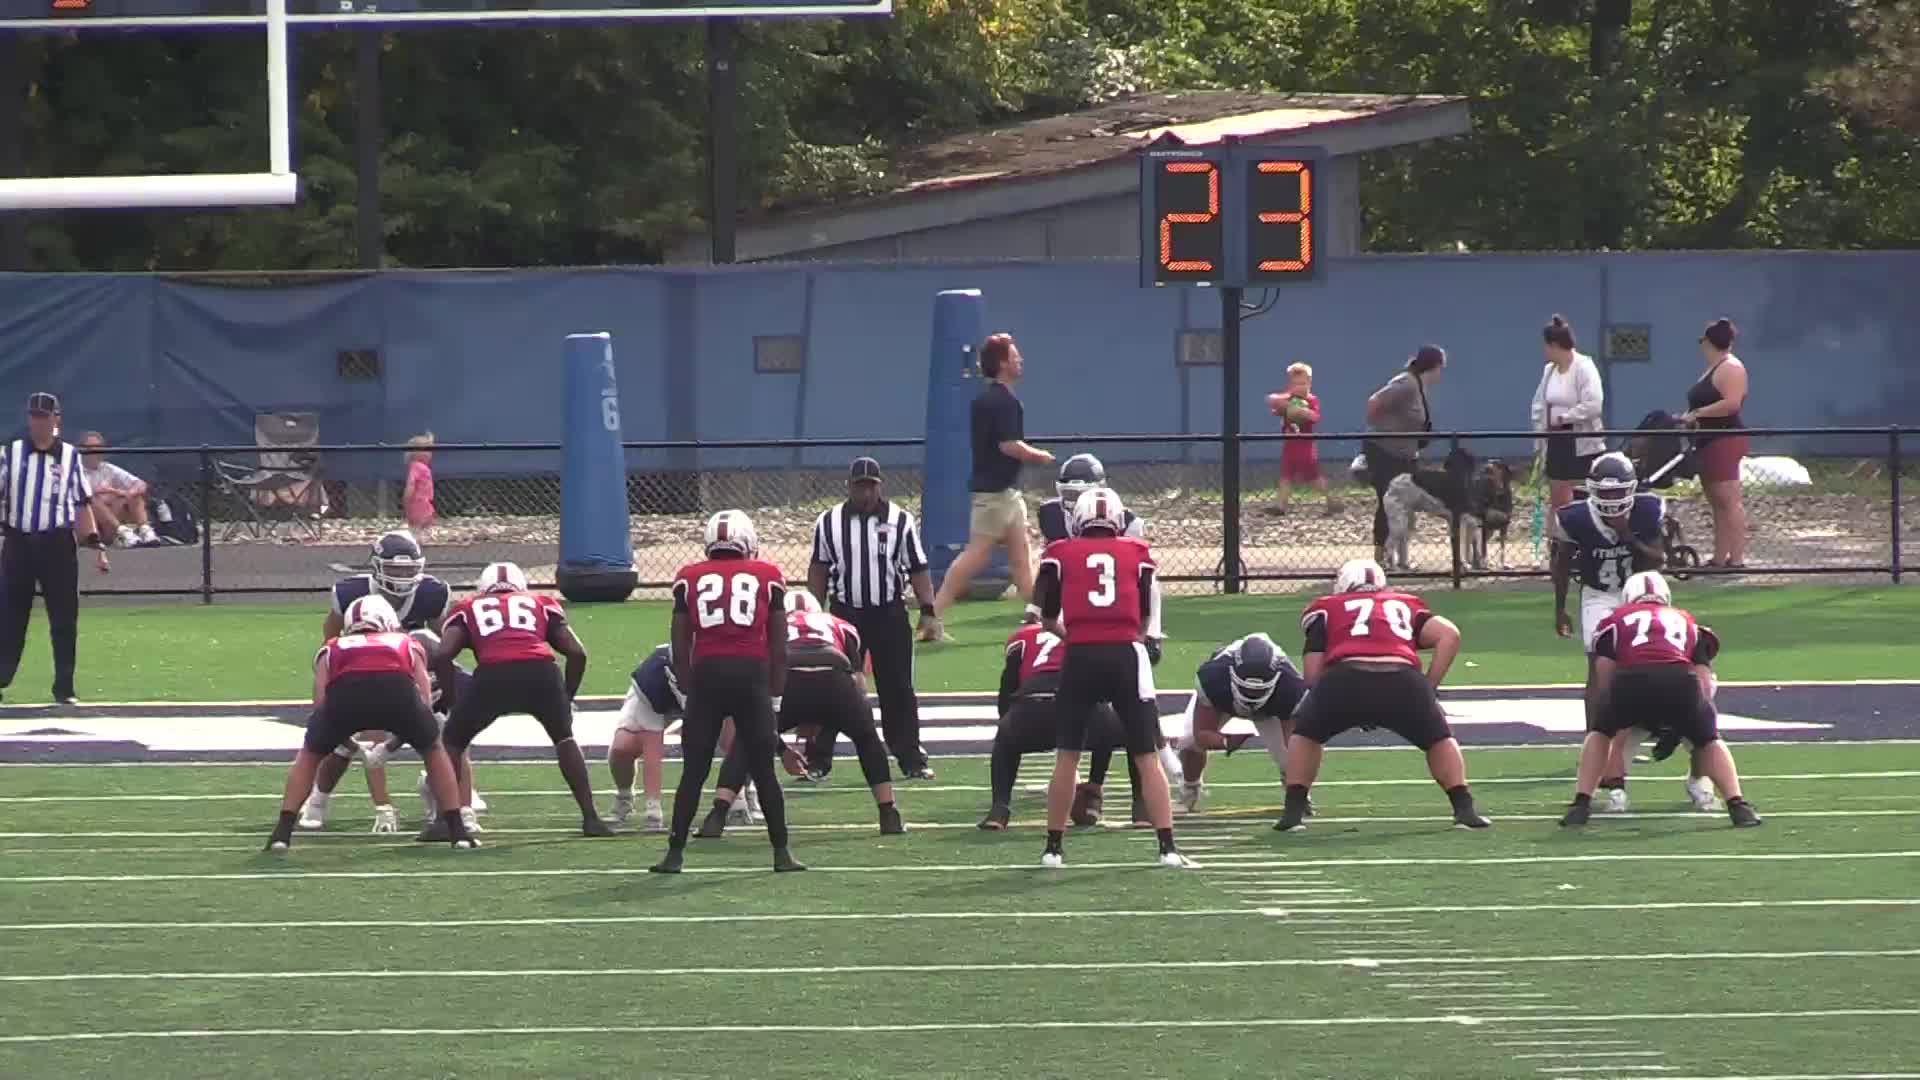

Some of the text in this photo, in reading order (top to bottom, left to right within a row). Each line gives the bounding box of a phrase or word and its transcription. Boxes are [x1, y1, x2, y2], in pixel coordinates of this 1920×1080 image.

[1160, 162, 1311, 272] 23
[697, 573, 760, 628] 28
[1086, 553, 1115, 607] 3
[472, 595, 537, 636] 66
[1032, 631, 1062, 667] 7
